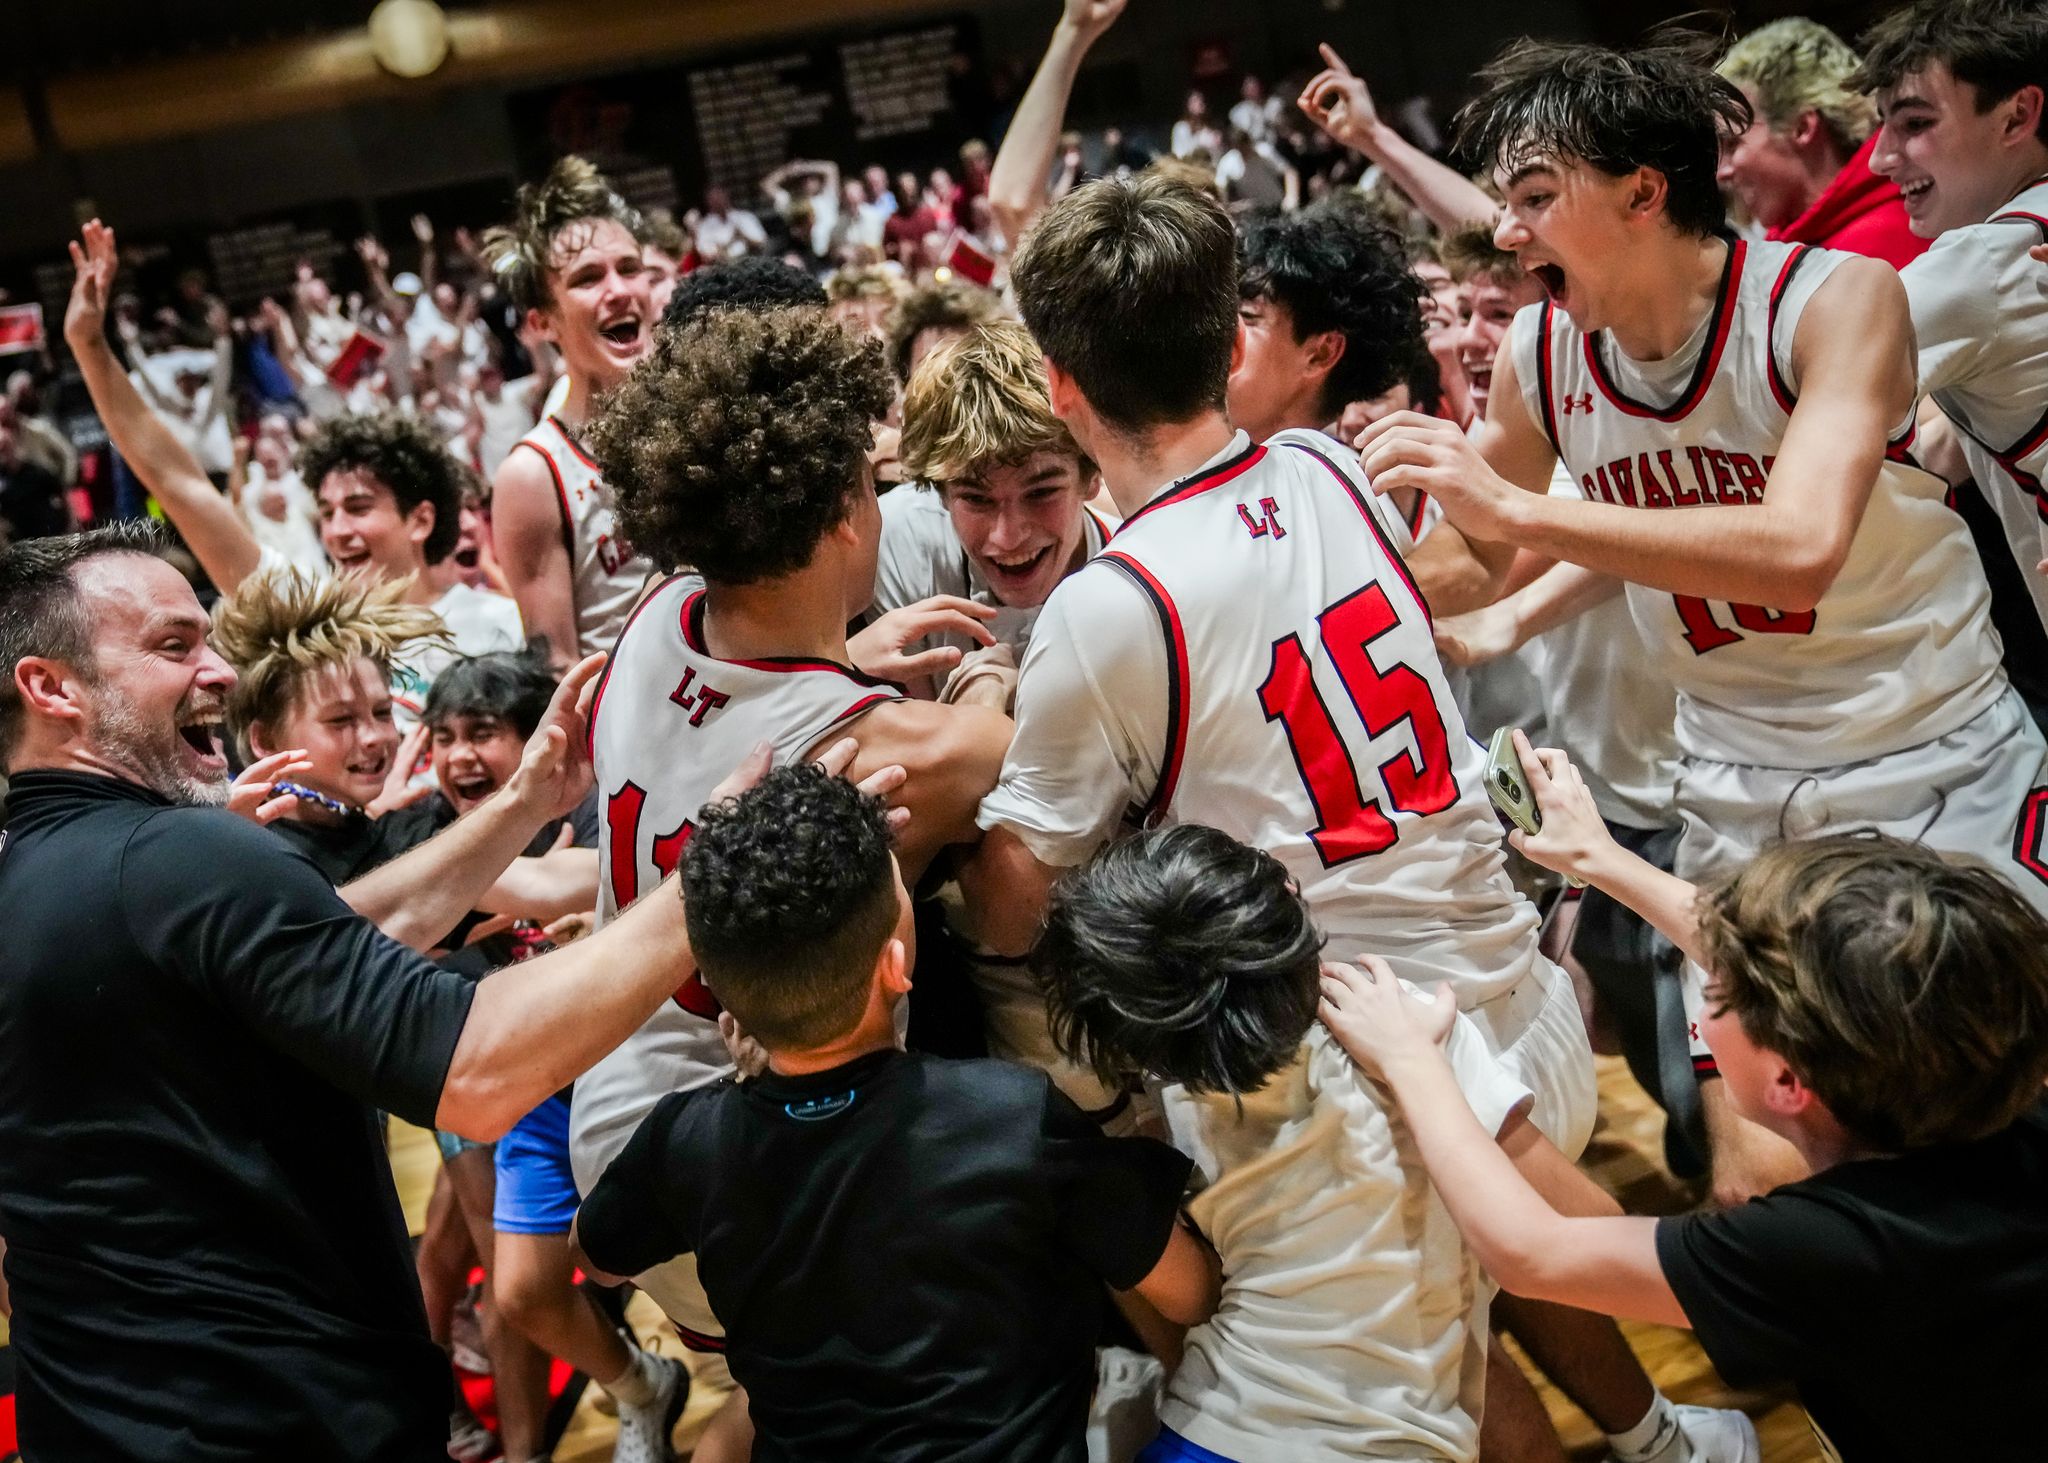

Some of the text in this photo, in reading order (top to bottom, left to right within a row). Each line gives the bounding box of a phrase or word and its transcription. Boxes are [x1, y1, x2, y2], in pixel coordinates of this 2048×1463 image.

[1236, 496, 1287, 540] LT
[668, 665, 732, 728] LT
[1256, 578, 1462, 869] 15
